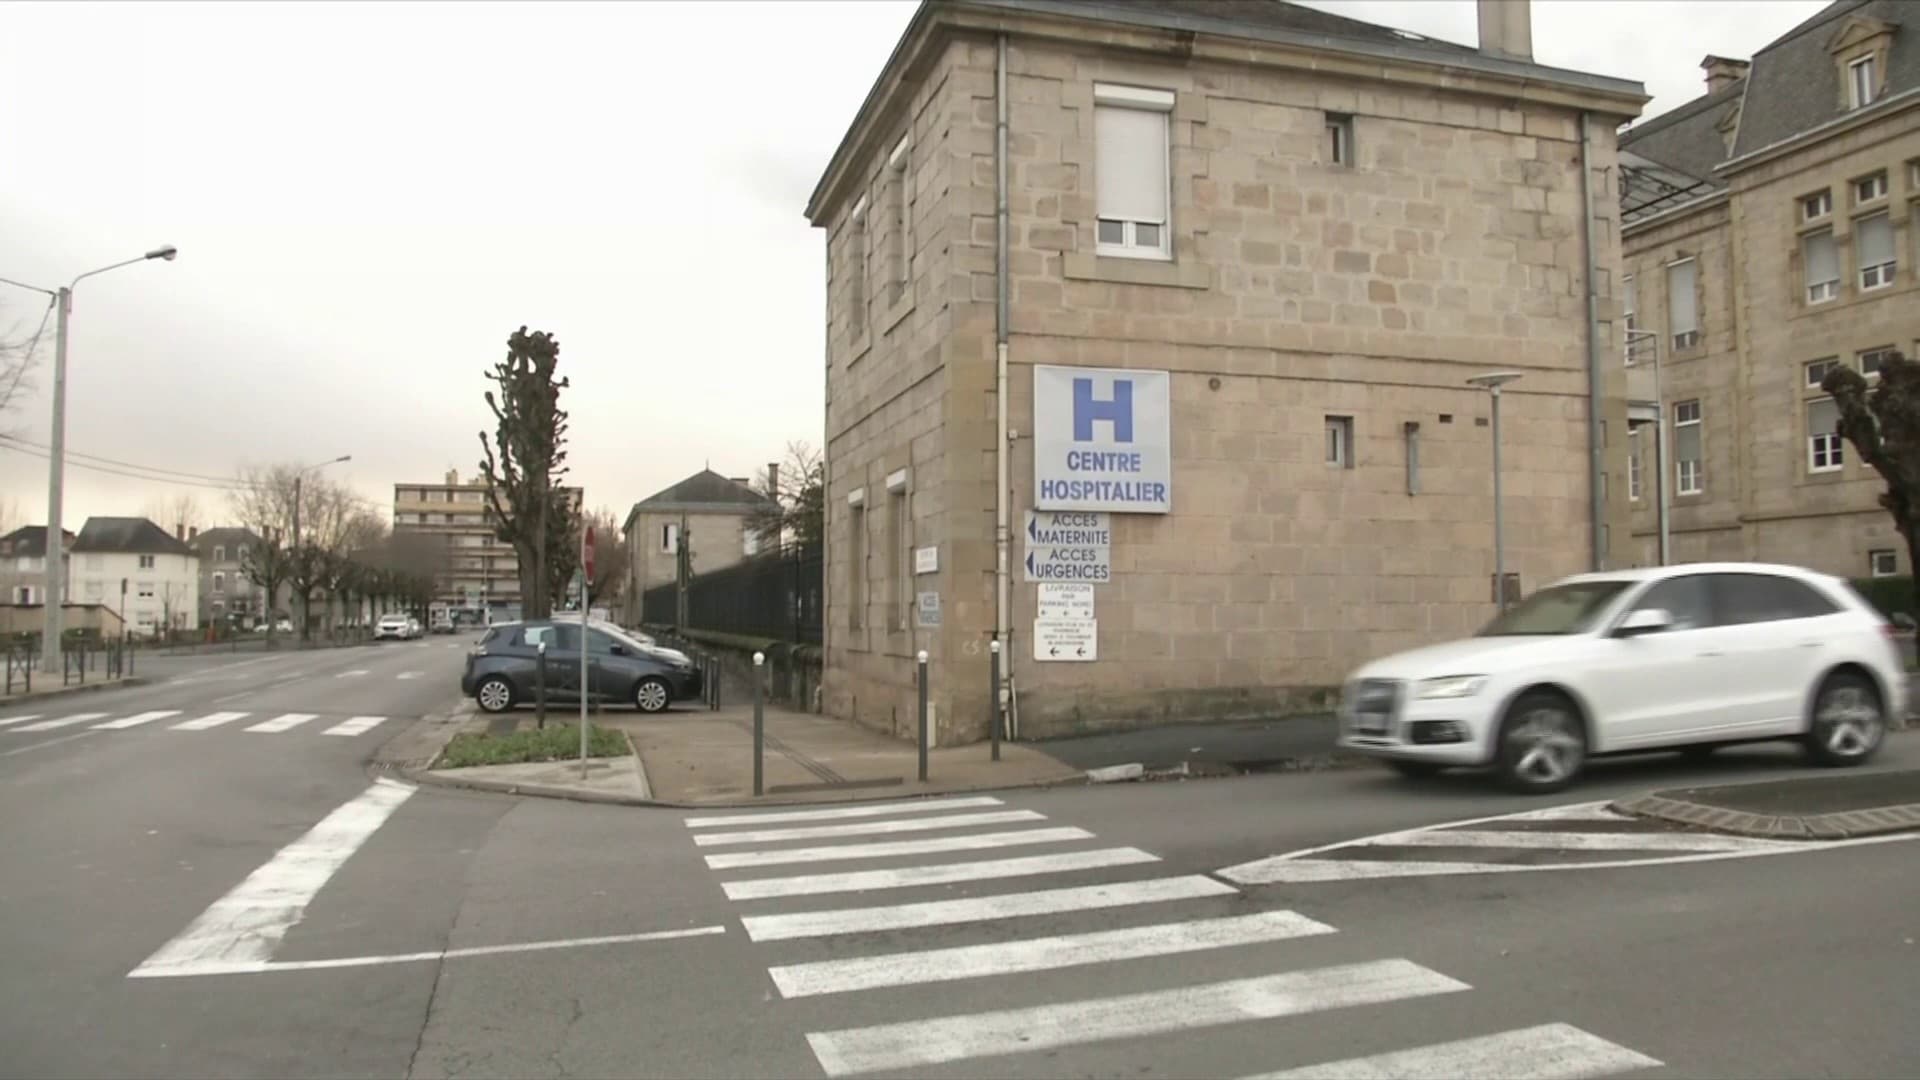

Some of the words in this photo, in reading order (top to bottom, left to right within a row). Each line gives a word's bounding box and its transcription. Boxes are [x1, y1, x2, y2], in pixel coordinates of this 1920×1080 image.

[1073, 378, 1132, 442] H
[1067, 451, 1141, 472] CENTRE
[1041, 480, 1165, 502] HOSPITALIER
[1052, 513, 1098, 527] ACCES
[1037, 530, 1108, 545] MATERNITE
[1049, 548, 1096, 561] ACCES
[1036, 564, 1108, 579] URGENCES
